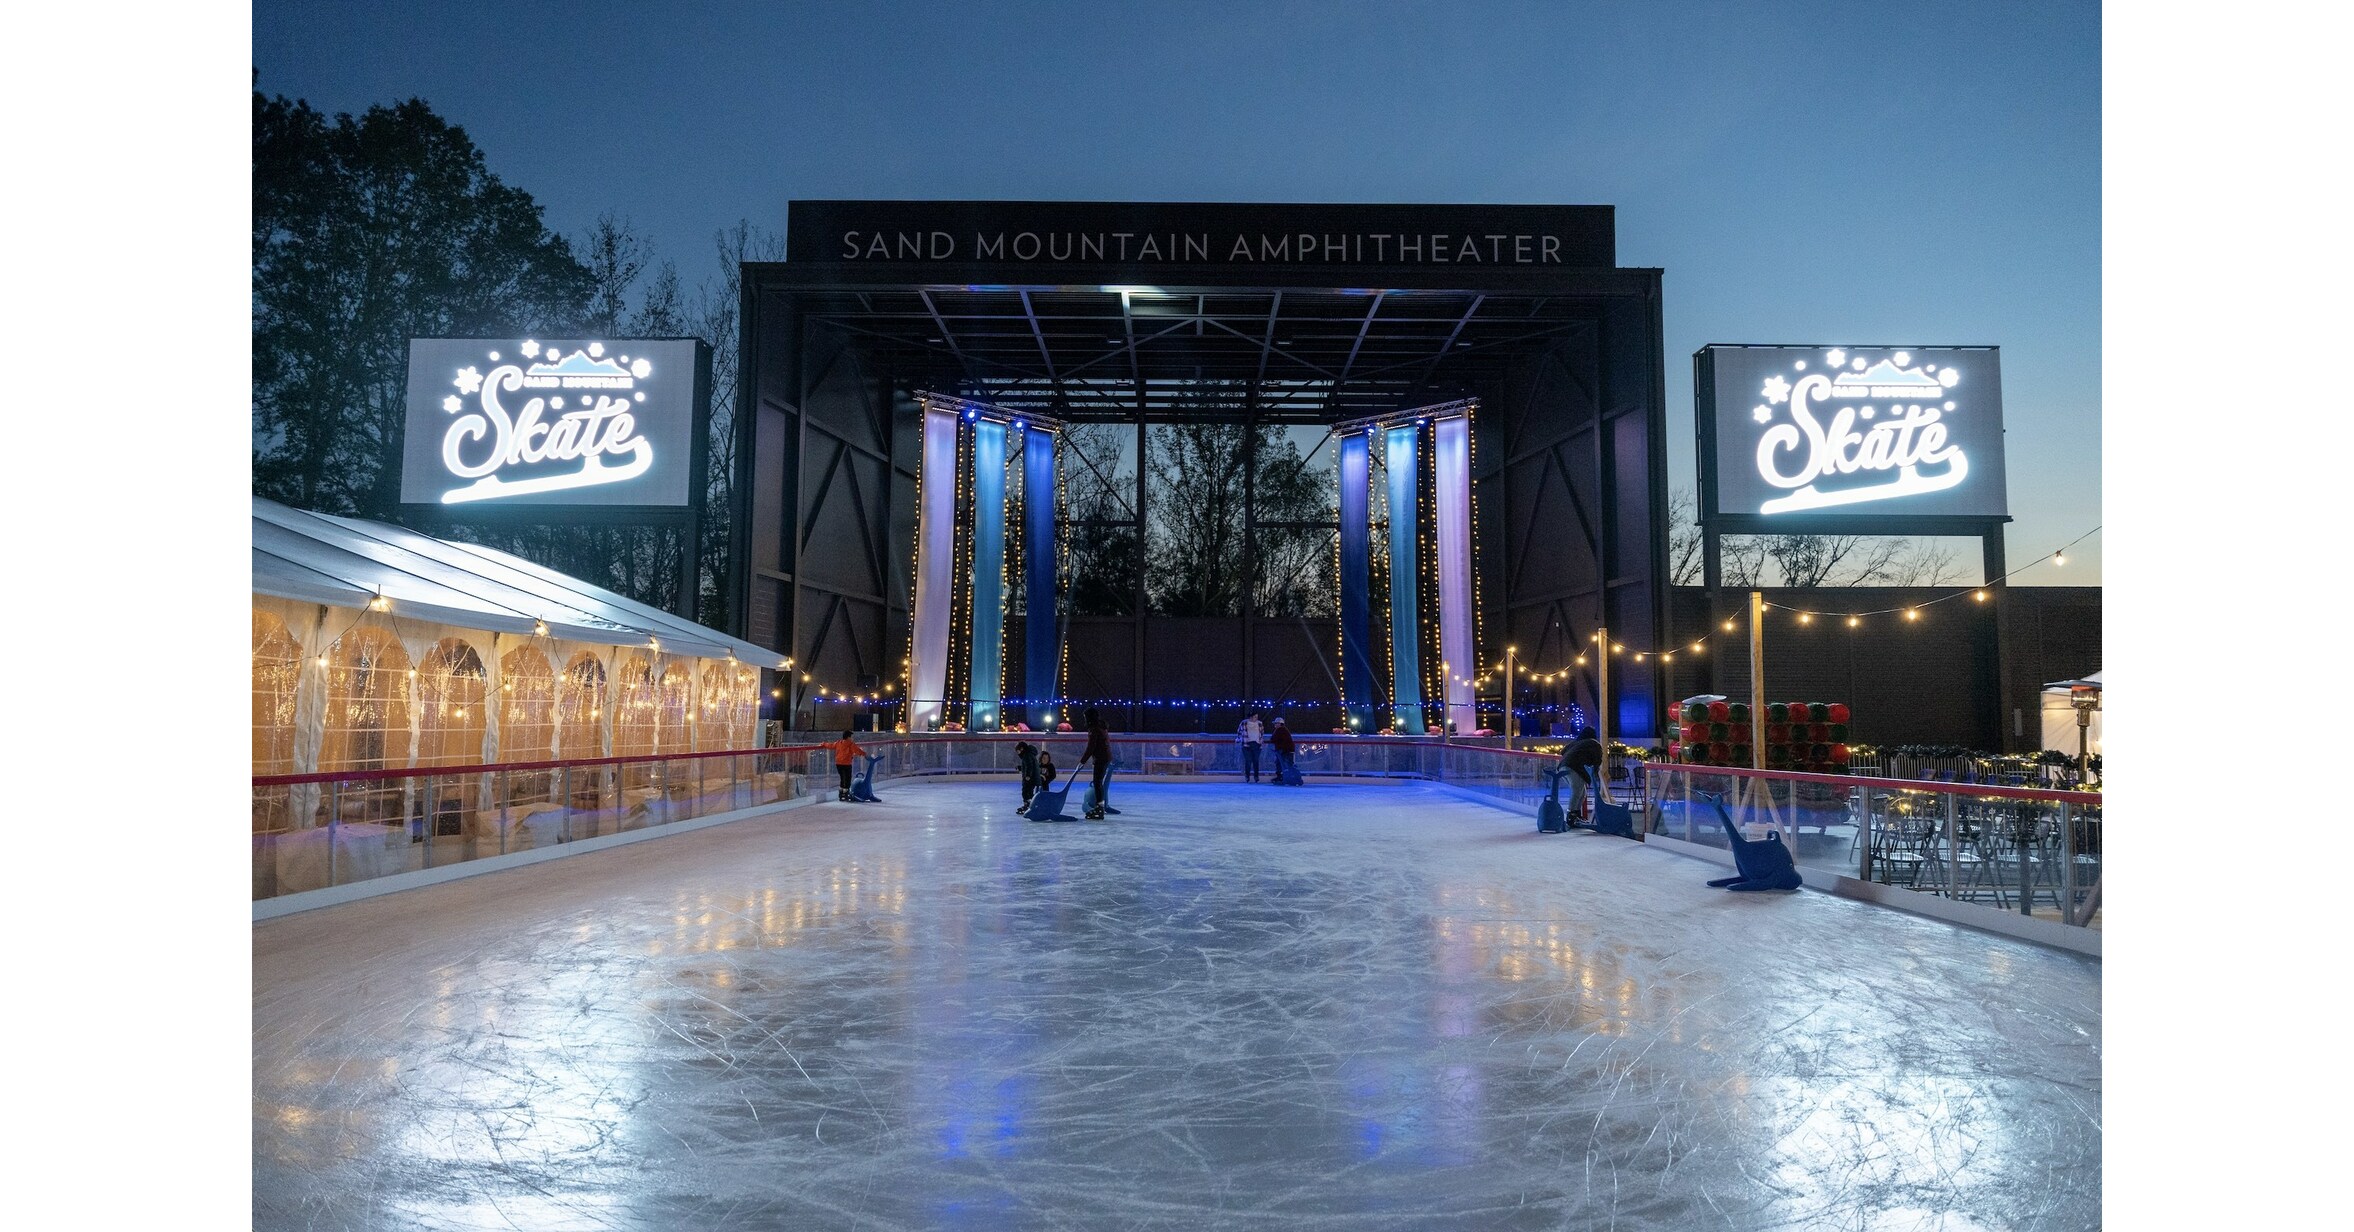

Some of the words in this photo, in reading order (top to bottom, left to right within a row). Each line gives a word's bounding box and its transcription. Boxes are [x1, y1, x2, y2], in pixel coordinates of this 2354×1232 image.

[843, 231, 955, 260] SAND
[976, 232, 1208, 261] MOUNTAIN
[1229, 233, 1562, 263] AMPHITHEATER
[443, 365, 646, 478] Skate
[1757, 374, 1960, 488] Skate
